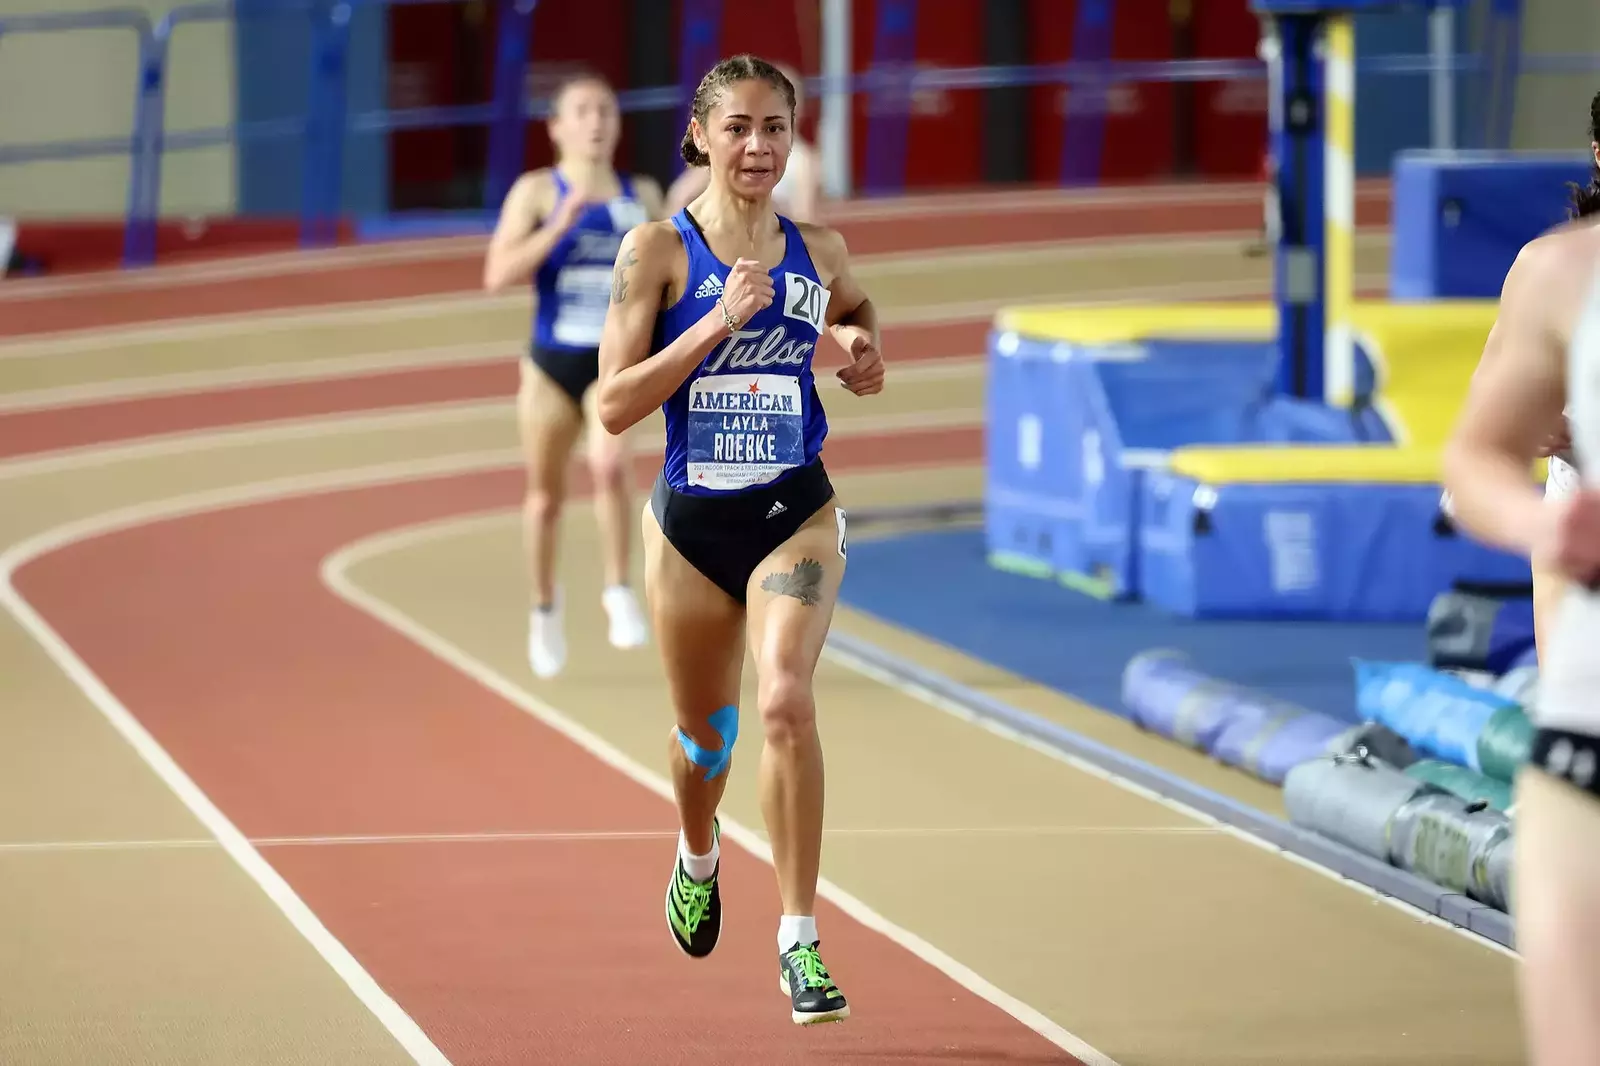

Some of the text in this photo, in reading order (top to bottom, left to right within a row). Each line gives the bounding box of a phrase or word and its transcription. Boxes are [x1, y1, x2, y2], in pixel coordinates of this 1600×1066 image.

[695, 287, 723, 299] adida
[792, 276, 821, 326] 20
[704, 325, 814, 373] Tulsa
[692, 391, 794, 412] AMERICAN
[723, 415, 768, 431] LAYLA
[714, 433, 777, 461] ROEBKE
